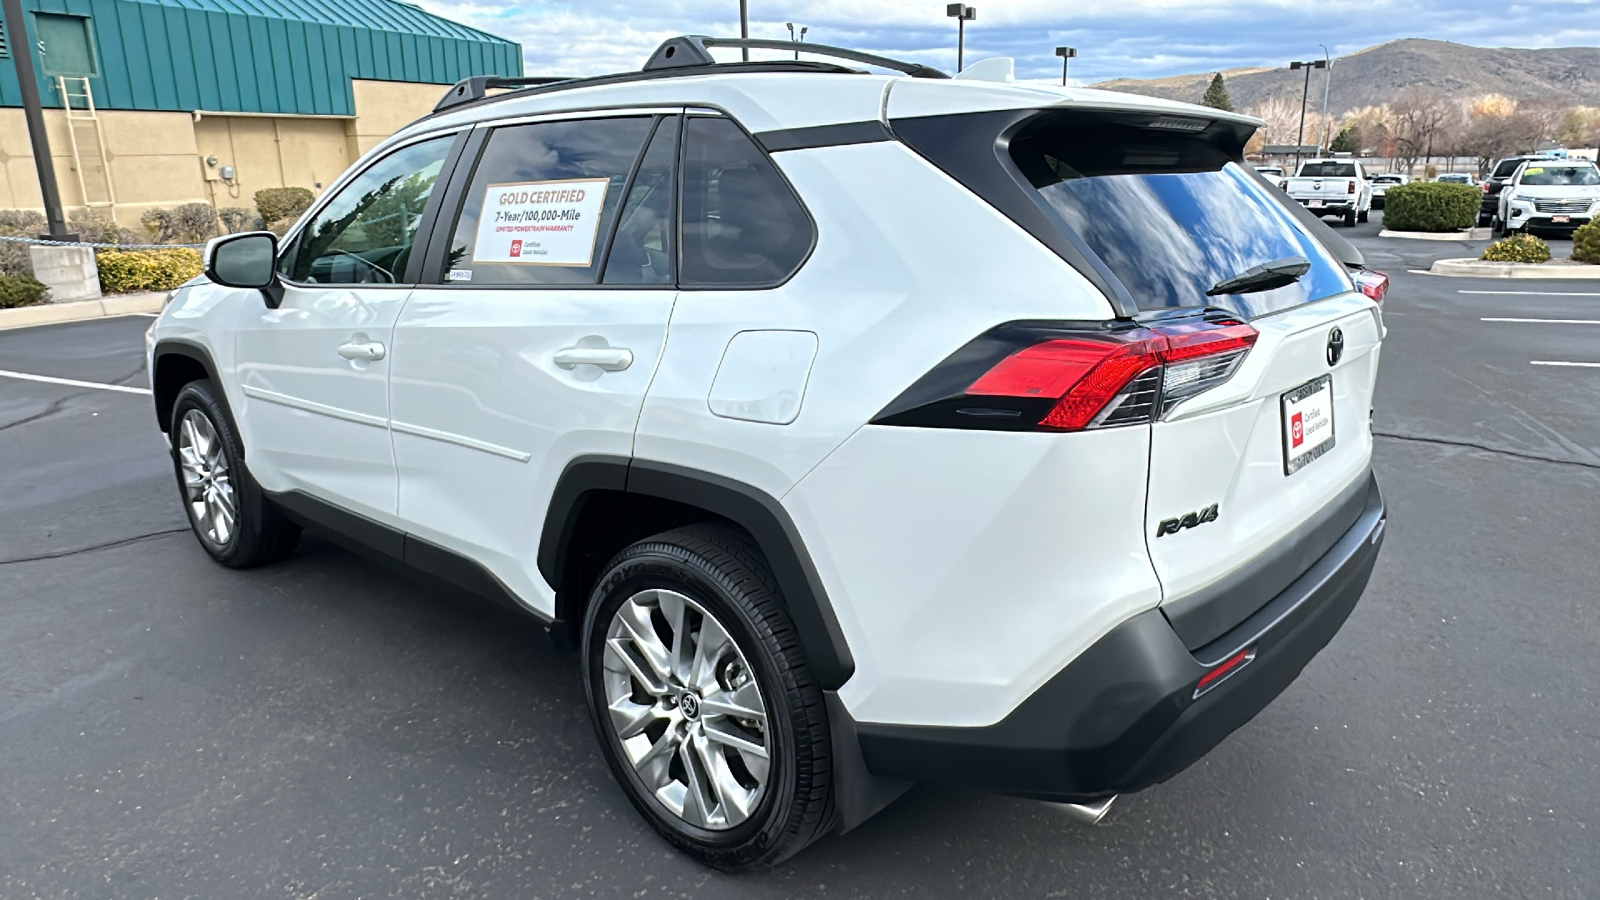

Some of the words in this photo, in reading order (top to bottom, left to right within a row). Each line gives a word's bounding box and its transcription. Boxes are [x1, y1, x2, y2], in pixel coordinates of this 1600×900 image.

[499, 192, 528, 206] GOLD
[529, 189, 585, 204] CERTIFIED
[495, 208, 581, 223] 7-Year/100,000-Mile
[1156, 502, 1219, 538] RAV4
